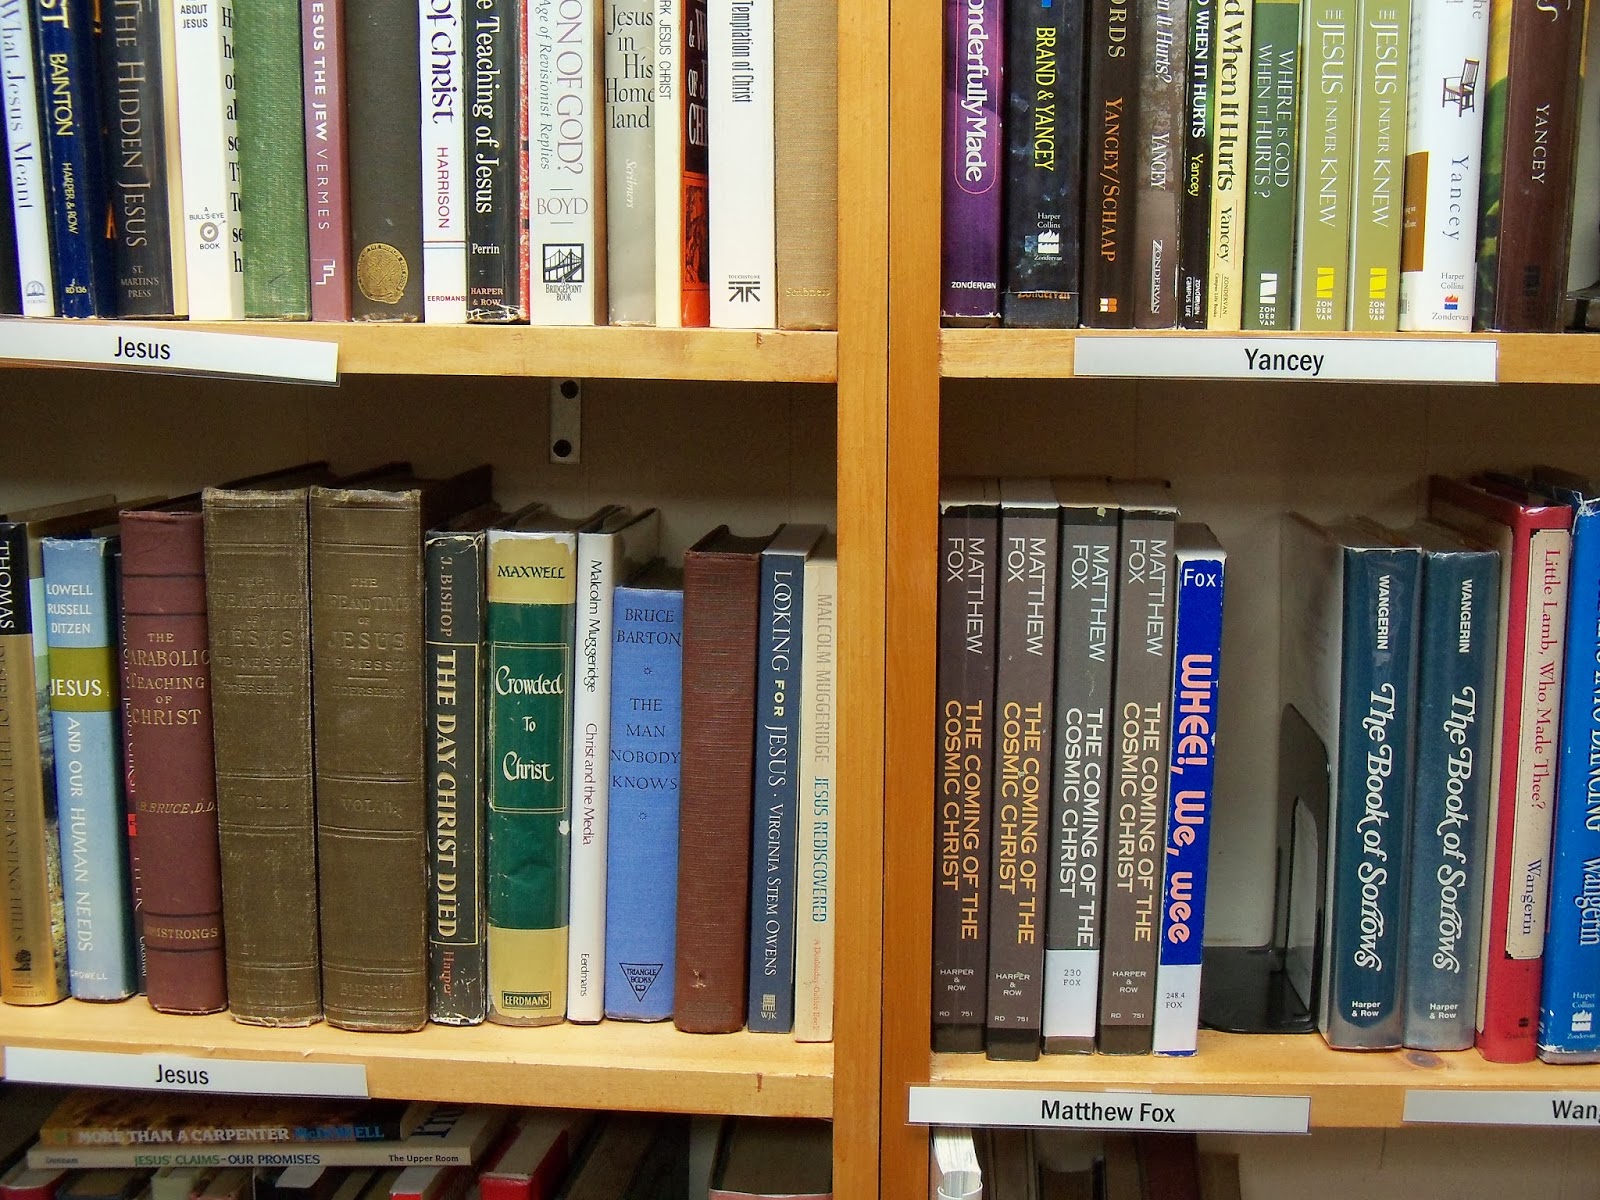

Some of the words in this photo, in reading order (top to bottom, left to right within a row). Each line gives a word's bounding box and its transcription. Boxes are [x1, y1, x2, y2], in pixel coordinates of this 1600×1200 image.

[181, 4, 207, 14] ABOUT
[183, 19, 208, 29] JESUS
[607, 4, 653, 35] Jesus
[1156, 12, 1173, 27] It
[1326, 10, 1345, 19] THE
[540, 25, 551, 38] of
[618, 29, 634, 51] in
[660, 20, 671, 55] JESUS
[729, 0, 754, 57] Temptation
[1195, 10, 1210, 59] WHEN
[472, 15, 500, 118] Teaching
[556, 51, 584, 88] OF
[731, 62, 753, 71] of
[1035, 26, 1056, 86] BRAND
[1155, 29, 1173, 84] Hurts?
[1194, 64, 1208, 79] IT
[1220, 22, 1243, 97] When
[1256, 44, 1273, 99] WHEN
[1317, 20, 1345, 95] JESUS
[49, 53, 73, 136] BAINTON
[314, 57, 327, 95] THE
[539, 43, 552, 119] Revisionist
[659, 61, 672, 99] CHRIST
[731, 75, 754, 102] Christ
[1276, 50, 1294, 121] WHERE
[6, 70, 26, 131] Jesus
[1037, 90, 1055, 101] &
[1191, 83, 1207, 139] HURTS
[1219, 101, 1240, 117] It
[1257, 105, 1268, 115] IT
[117, 62, 145, 169] HIDDEN
[313, 102, 327, 141] JEW
[556, 94, 584, 175] GOD?
[611, 105, 650, 129] land
[1278, 127, 1288, 136] IS
[1324, 107, 1338, 153] NEVER
[475, 126, 500, 146] of
[537, 121, 552, 170] Replies
[965, 117, 988, 182] Made
[1033, 104, 1055, 171] YANCEY
[1531, 103, 1550, 184] YANCEY
[13, 142, 33, 209] Meant
[1151, 132, 1169, 190] YANCEY
[1188, 153, 1204, 197] Yancey
[1216, 123, 1239, 191] Hurts
[1274, 141, 1291, 187] GOD
[316, 149, 330, 230] VERMES
[436, 147, 450, 228] HARRISON
[475, 153, 500, 213] Jesus
[1318, 159, 1338, 228] KNEW
[117, 181, 150, 248] JESUS
[537, 197, 588, 215] BOYD
[1037, 212, 1061, 222] Harper
[1037, 221, 1061, 229] Collins
[472, 243, 500, 255] Perrin
[1217, 206, 1233, 263] Yancey
[128, 289, 152, 297] PRESS
[471, 288, 503, 296] HARPER
[1441, 272, 1465, 281] Harper
[1441, 282, 1464, 290] Collins
[1432, 312, 1469, 321] Zondervan
[114, 336, 171, 360] Jesus
[1244, 348, 1325, 376] Yancey
[497, 565, 566, 579] MAXWELL
[947, 537, 964, 583] FOX
[1007, 537, 1025, 583] FOX
[1183, 568, 1217, 587] Fox
[1544, 549, 1561, 595] Little
[0, 540, 15, 629] THOMAS
[46, 584, 93, 596] LOWELL
[589, 559, 603, 615] Malcolm
[966, 537, 985, 655] MATTHEW
[1026, 537, 1046, 656] MATTHEW
[47, 603, 92, 615] RUSSELL
[440, 575, 453, 637] BISHOP
[625, 608, 674, 623] BRUCE
[771, 570, 792, 672] LOOKING
[1377, 574, 1390, 650] WANGERIN
[1458, 579, 1473, 653] WANGERIN
[51, 623, 91, 634] DITZEN
[148, 633, 175, 643] THE
[616, 630, 681, 647] BARTON
[816, 594, 832, 664] MALCOLM
[1540, 601, 1558, 655] Lamb,
[583, 619, 601, 693] Muggeridge
[129, 672, 205, 690] TEACHING
[436, 650, 457, 706] THE
[495, 665, 564, 696] Crowded
[1537, 661, 1555, 703] Who
[132, 709, 202, 725] CHRIST
[155, 696, 173, 704] OF
[774, 680, 785, 717] FOR
[815, 670, 831, 763] MUGGERIDGE
[1362, 682, 1396, 742] The
[67, 717, 82, 753] AND
[436, 714, 457, 769] DAY
[522, 716, 537, 732] To
[584, 723, 598, 759] Christ
[626, 724, 666, 738] MAN
[965, 700, 983, 749] THE
[1534, 709, 1553, 755] Made
[502, 751, 554, 782] Christ
[611, 749, 681, 764] NOBODY
[765, 724, 788, 788] JESUS
[943, 700, 962, 795] COSMIC
[68, 761, 83, 797] OUR
[584, 760, 596, 778] and
[584, 778, 597, 797] the
[612, 775, 678, 790] KNOWS
[1531, 759, 1550, 810] Thee?
[813, 775, 829, 817] JESUS
[963, 754, 981, 850] COMING
[1356, 744, 1393, 833] Book
[436, 771, 458, 868] CHRIST
[582, 799, 596, 846] Media
[767, 803, 784, 873] VIRGINIA
[70, 807, 88, 881] HUMAN
[942, 801, 960, 890] CHRIST
[1364, 831, 1389, 862] of
[812, 821, 829, 923] REDISCOVERED
[962, 856, 979, 889] OF
[437, 874, 458, 938] DIED
[765, 878, 782, 916] STEM
[1520, 858, 1542, 936] Wangerin
[75, 891, 93, 952] NEEDS
[961, 893, 978, 940] THE
[1354, 862, 1388, 972] Sorrows
[764, 920, 781, 976] OWENS
[71, 969, 108, 981] CROWELL
[580, 952, 590, 997] Eerdmans
[626, 968, 657, 977] TRIANGLE
[630, 975, 652, 984] BOOKS
[947, 984, 966, 992] ROW
[1063, 969, 1082, 977] 230
[504, 996, 549, 1007] EERDMANS
[1572, 992, 1596, 1000] Harper
[1572, 1001, 1595, 1009] Collins
[760, 1011, 777, 1020] WJK
[1566, 1032, 1596, 1040] Zondervan
[155, 1063, 209, 1085] Jesus
[1040, 1099, 1133, 1122] Matthew
[1139, 1102, 1176, 1123] Fox
[1552, 1100, 1600, 1123] Wan
[78, 1130, 123, 1143] MORE
[128, 1130, 173, 1143] THAN
[177, 1129, 189, 1142] A
[192, 1127, 289, 1141] CARPENTER
[388, 1154, 404, 1162] The
[406, 1154, 433, 1164] Upper
[435, 1154, 459, 1162] Room
